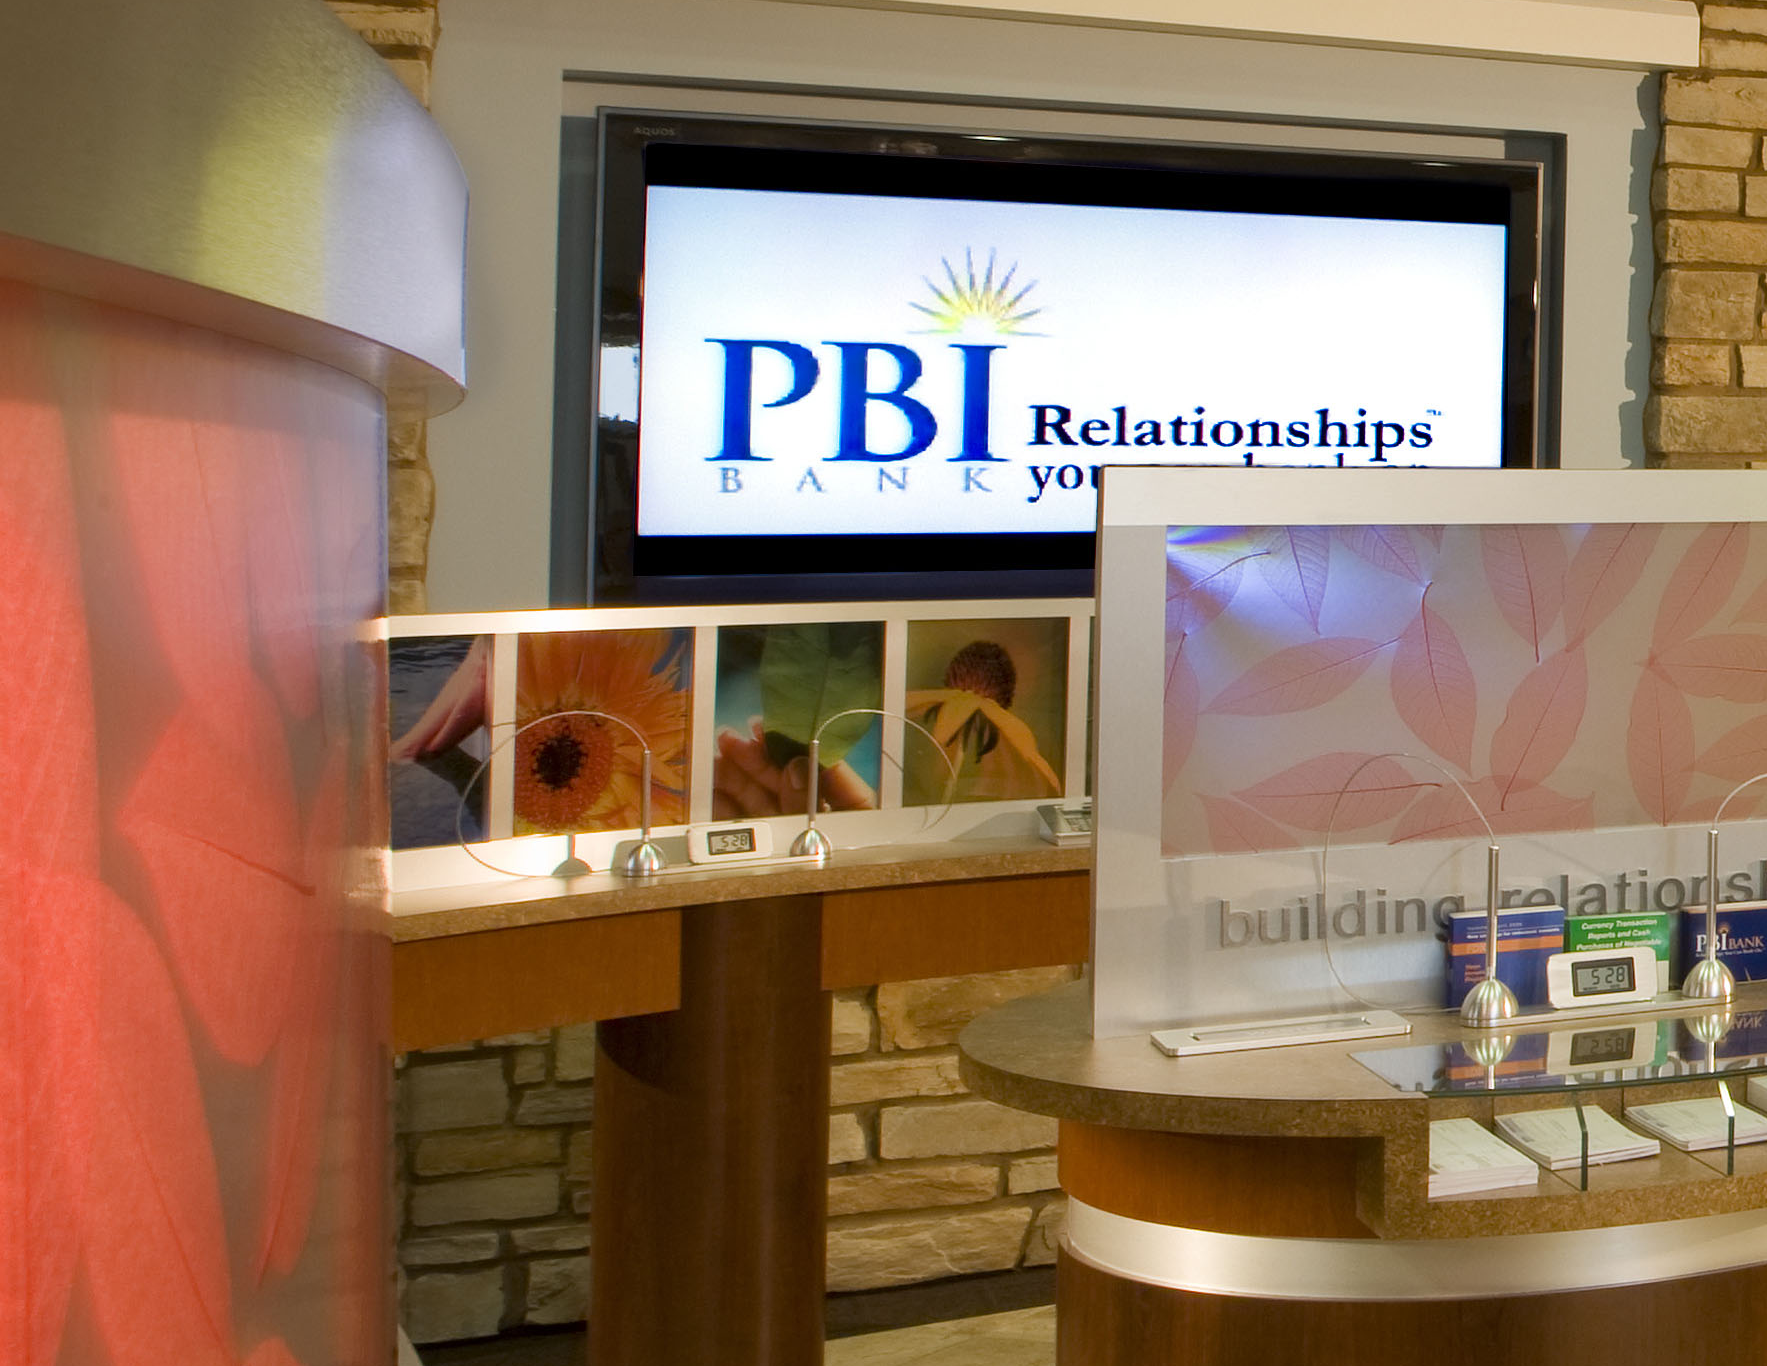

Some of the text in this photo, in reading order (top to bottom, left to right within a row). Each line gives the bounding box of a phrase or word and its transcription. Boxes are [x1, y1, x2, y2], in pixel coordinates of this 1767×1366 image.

[704, 337, 1009, 464] PBI
[718, 465, 994, 495] BANK
[1729, 936, 1765, 949] BANK
[1591, 966, 1625, 985] 5 28
